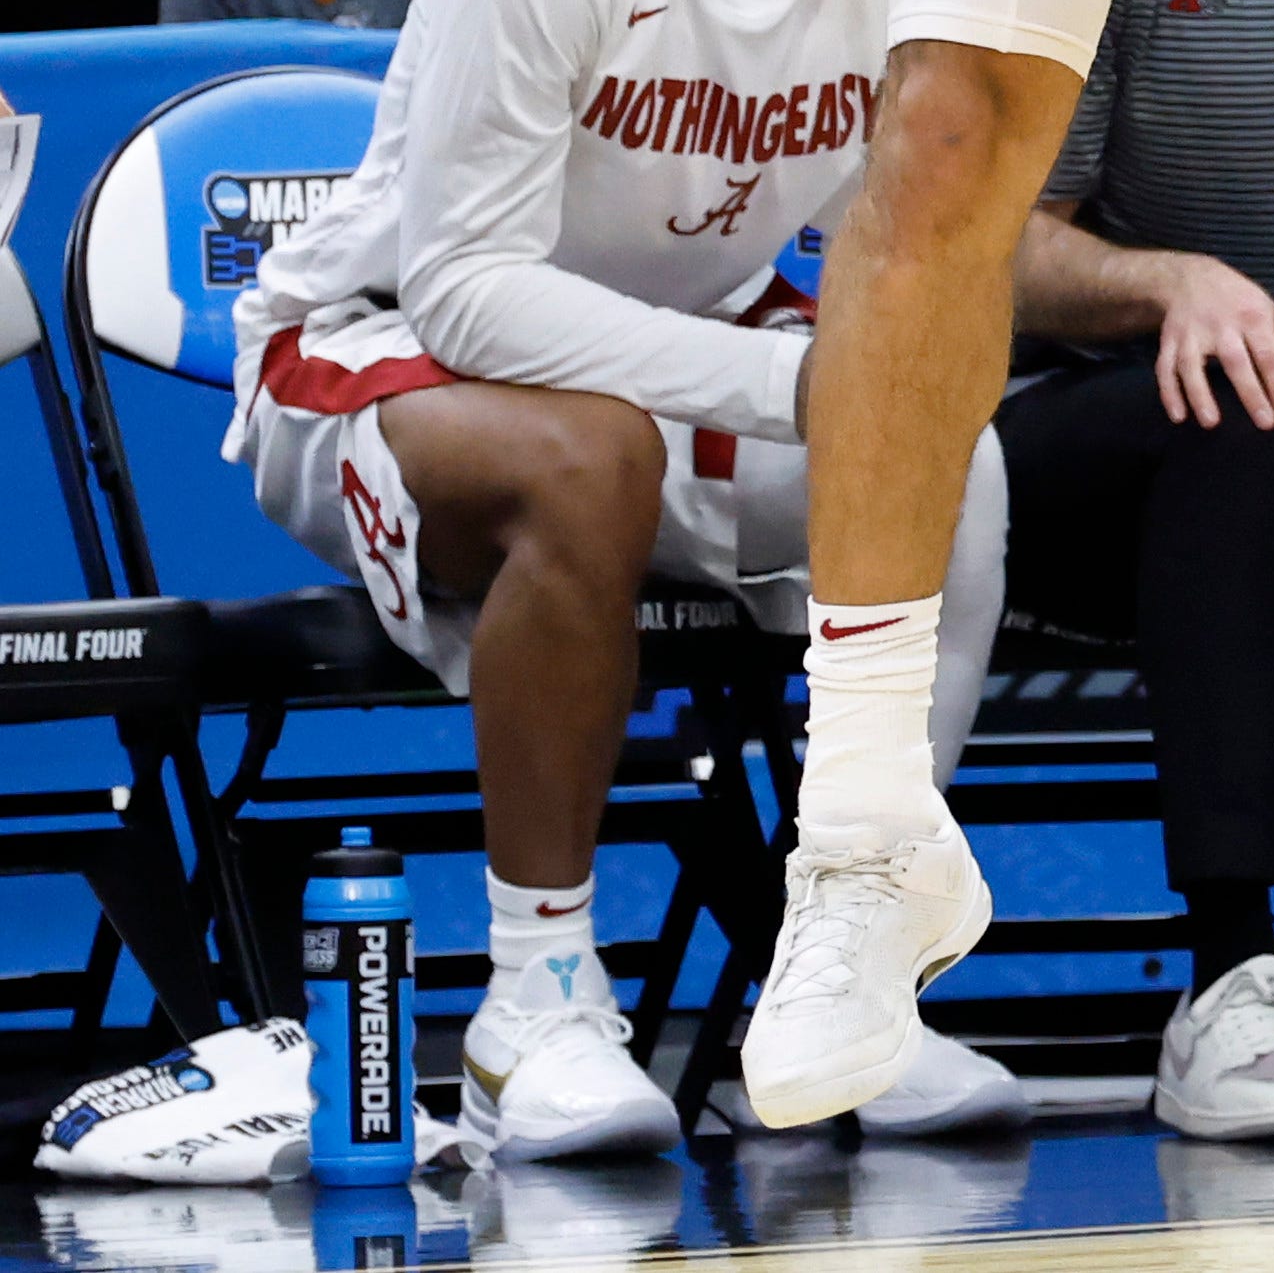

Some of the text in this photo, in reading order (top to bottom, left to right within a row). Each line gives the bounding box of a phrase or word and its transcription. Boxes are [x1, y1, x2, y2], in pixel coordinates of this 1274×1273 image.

[674, 600, 739, 631] FOUR
[0, 628, 144, 664] FINAL FOUR
[357, 925, 392, 1135] POWERADE
[87, 1073, 185, 1119] MARCH
